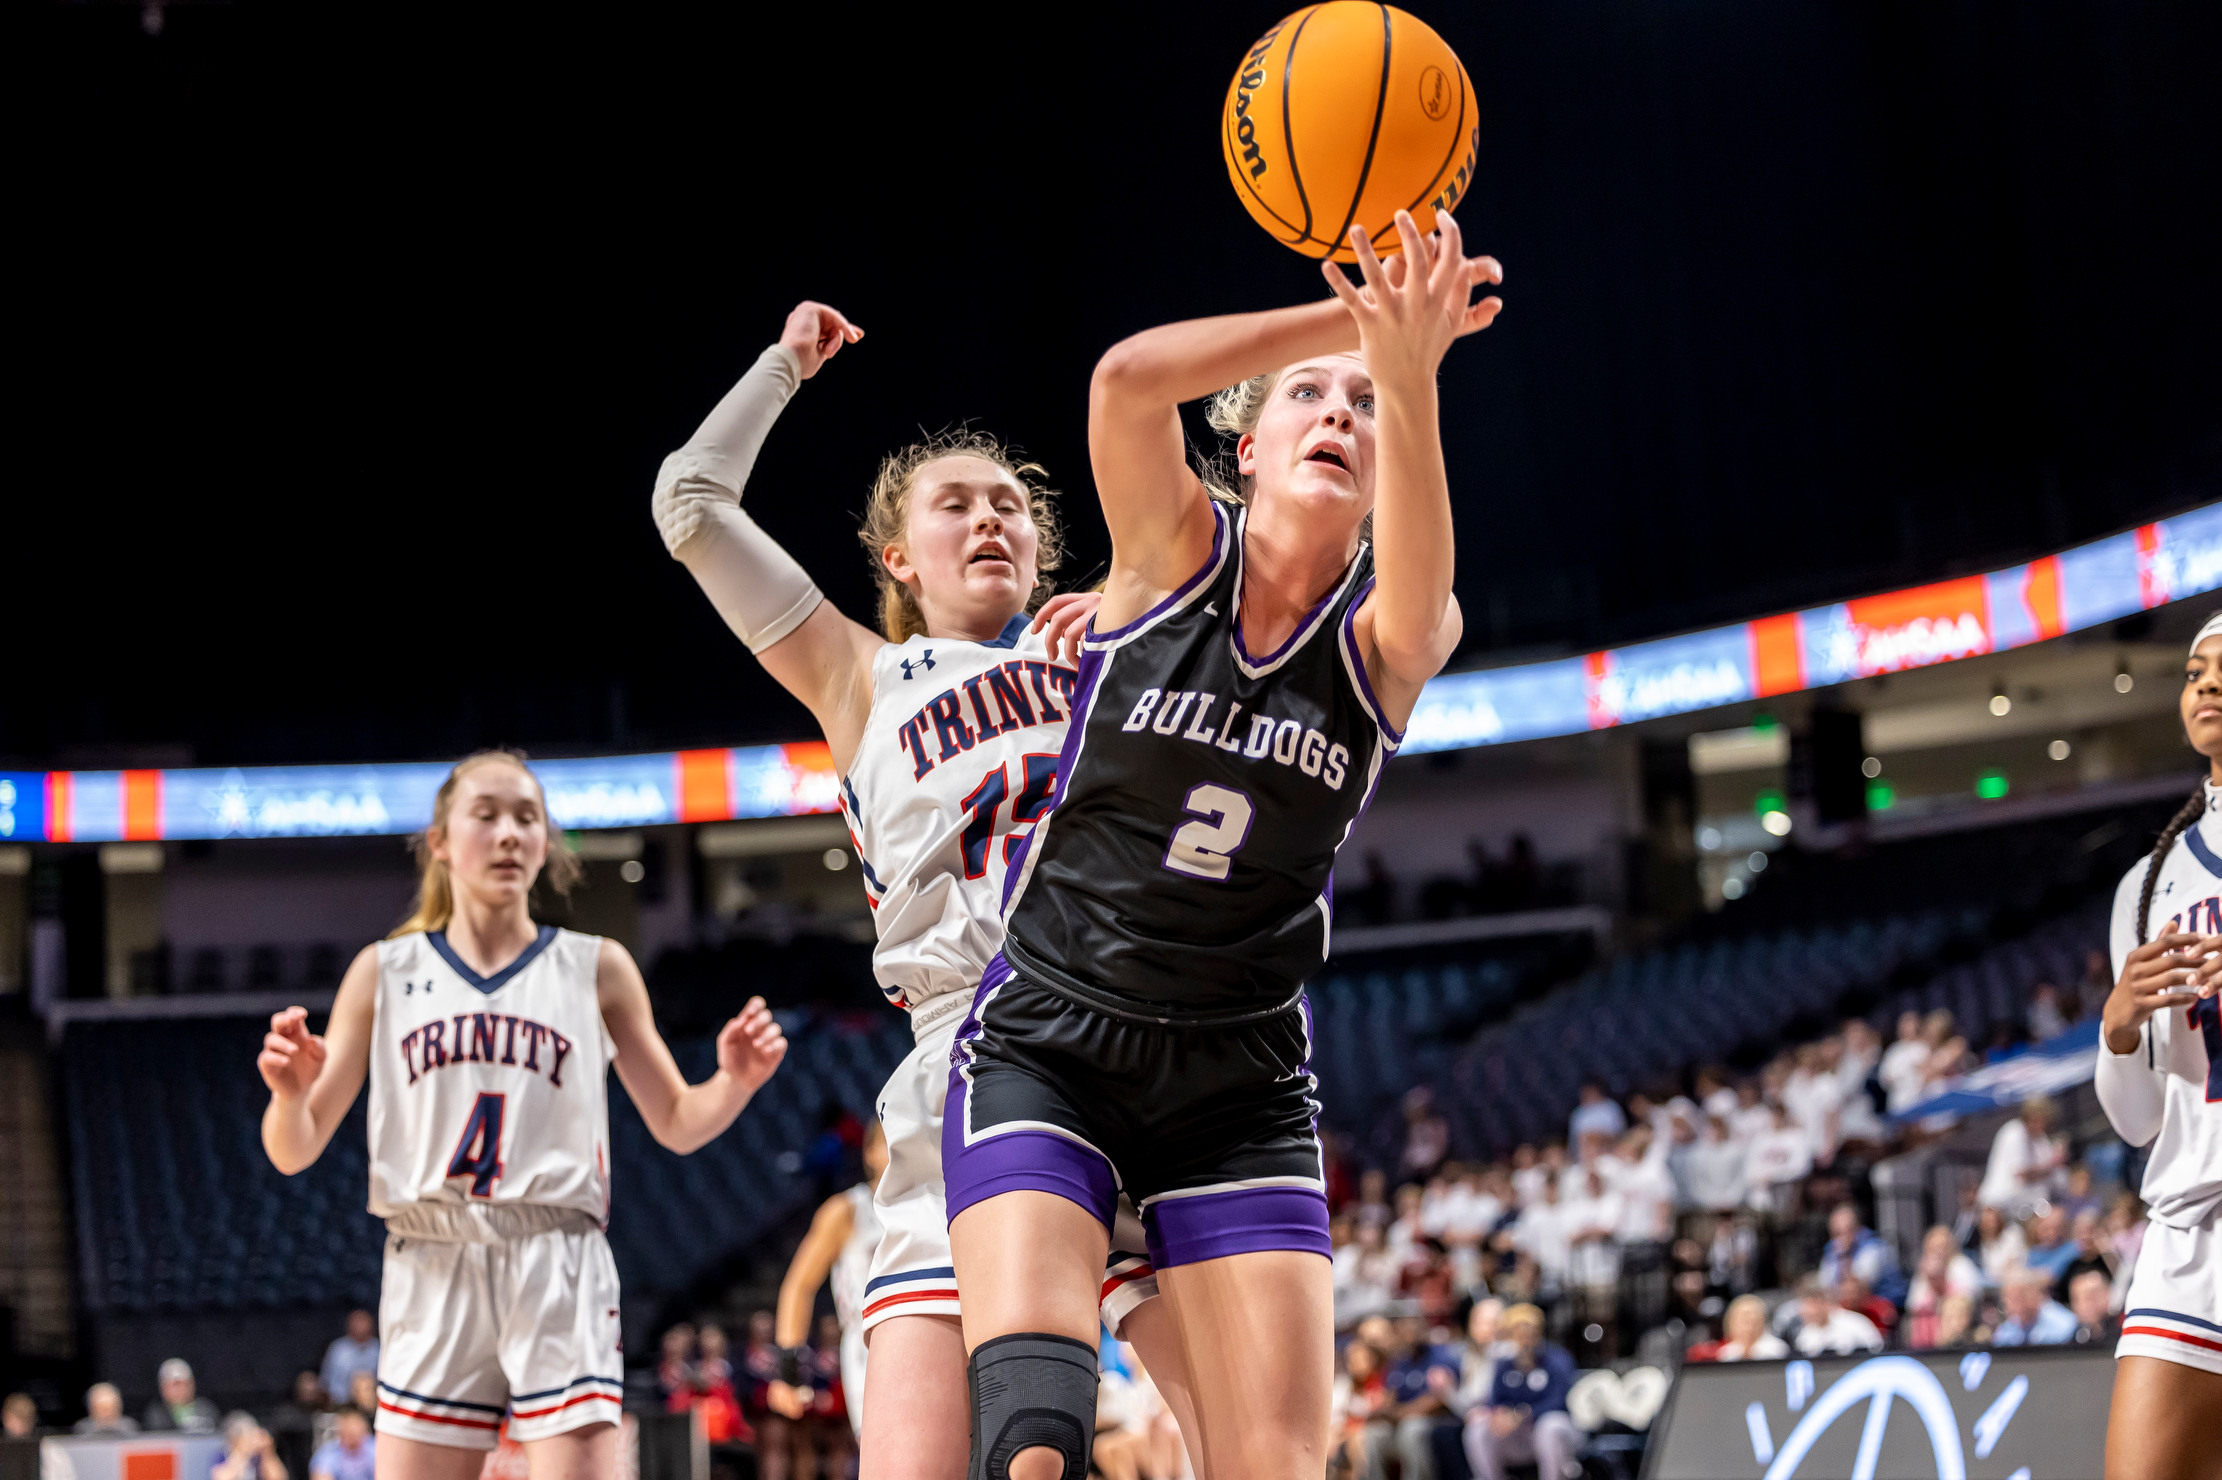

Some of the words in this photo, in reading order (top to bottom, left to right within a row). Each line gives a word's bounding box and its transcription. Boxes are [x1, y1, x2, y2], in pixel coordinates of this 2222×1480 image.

[898, 659, 1078, 783] TRINIT
[1121, 687, 1349, 791] BULLDOGS
[960, 752, 1062, 881] 15
[1161, 780, 1257, 883] 2
[401, 1012, 572, 1089] TRINITY
[446, 1091, 507, 1197] 4
